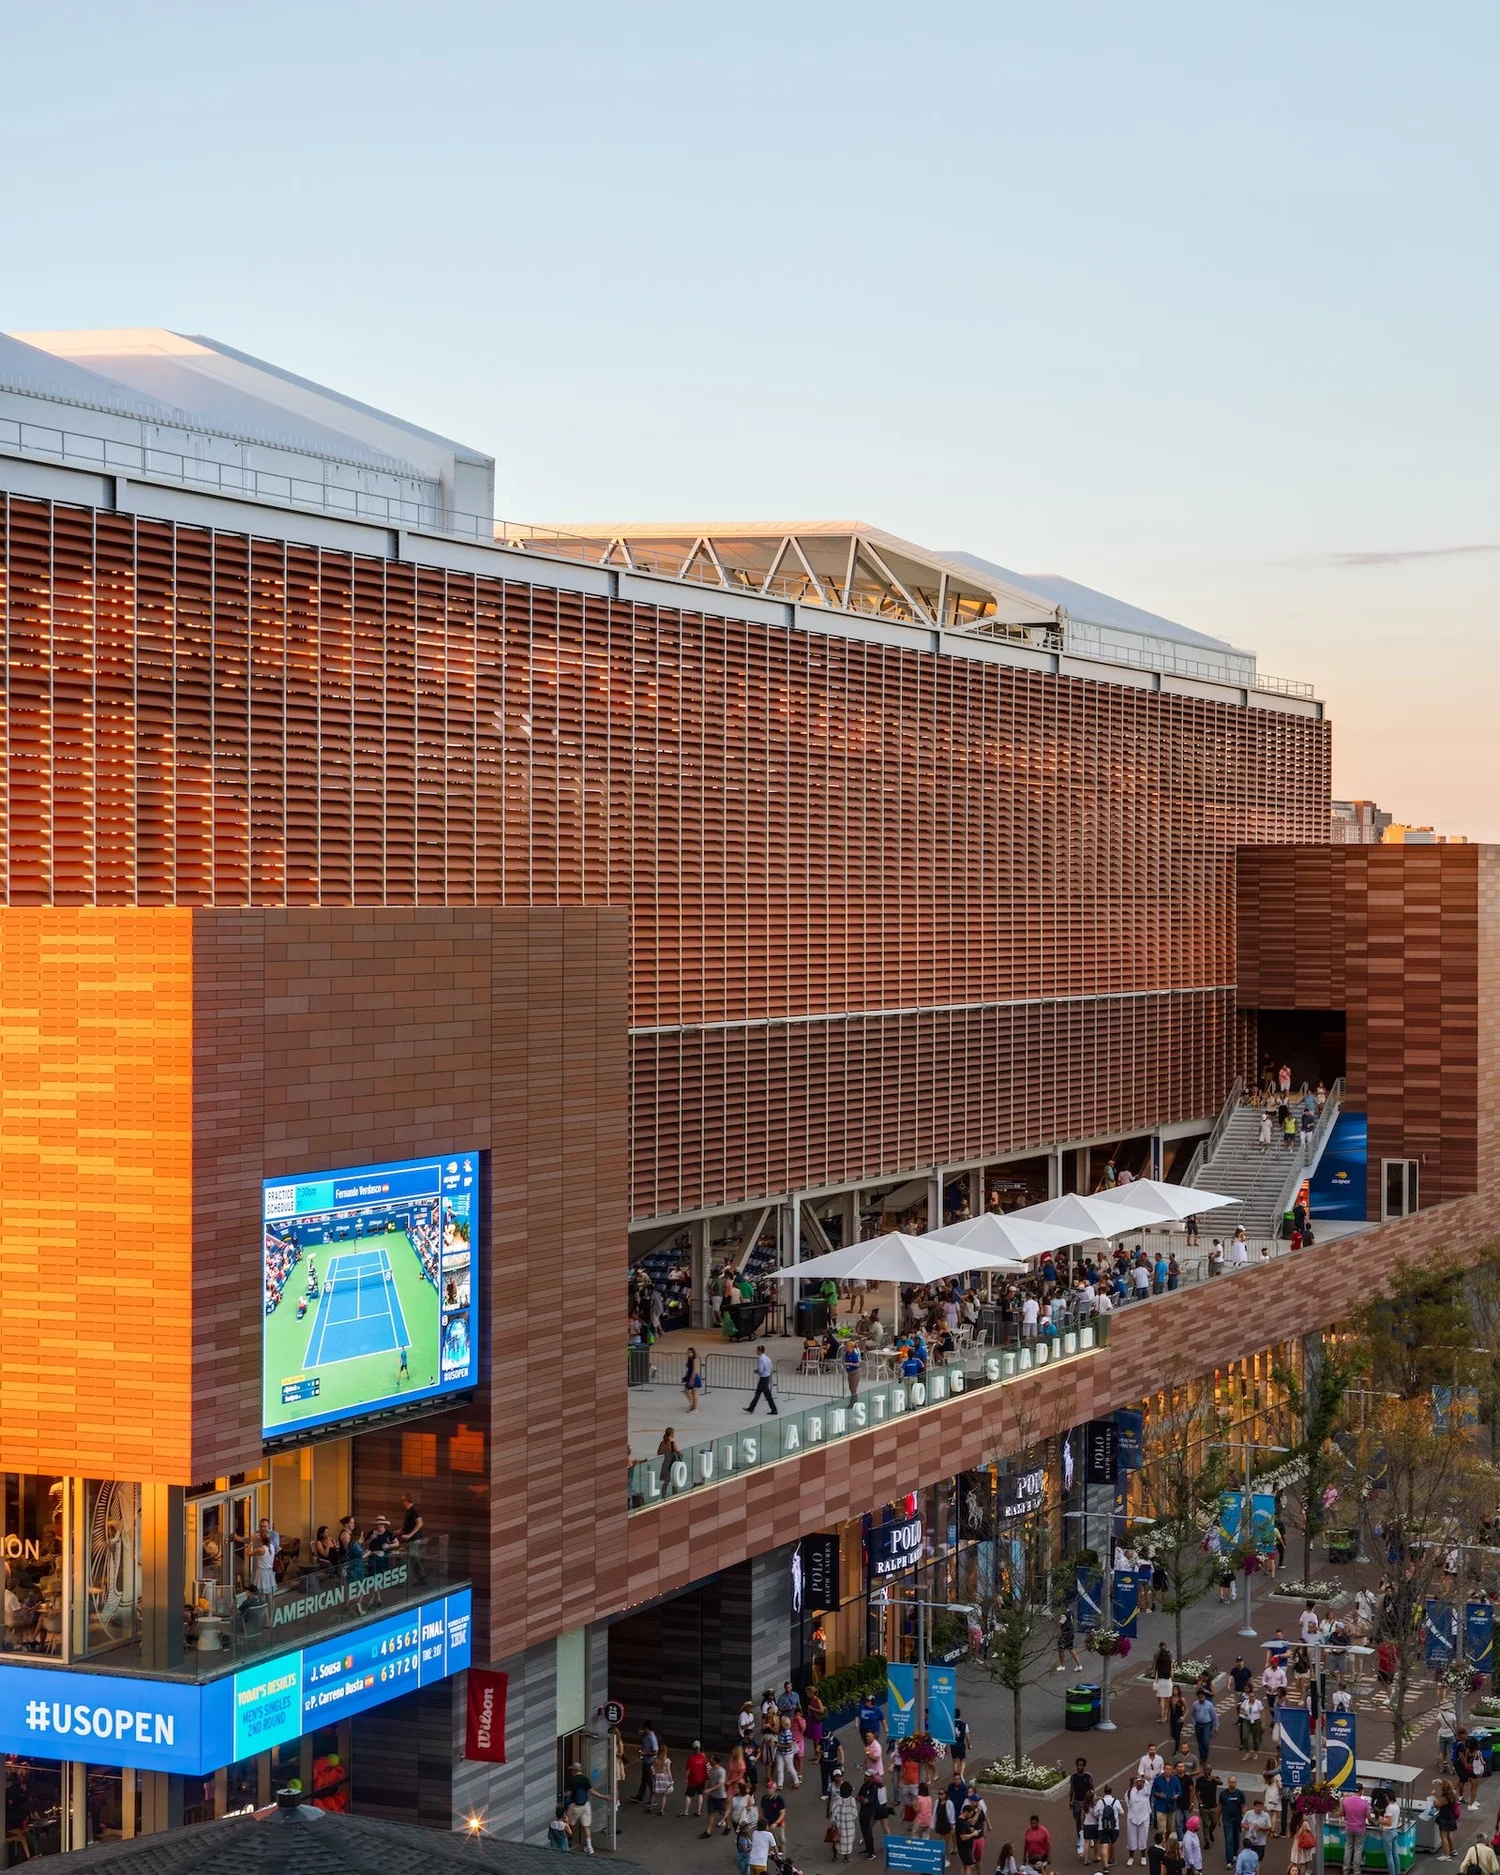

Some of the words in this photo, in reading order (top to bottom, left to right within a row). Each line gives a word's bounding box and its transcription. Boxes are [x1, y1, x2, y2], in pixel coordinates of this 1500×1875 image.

[267, 1201, 294, 1214] SCHEDULE
[268, 1189, 293, 1201] PRACTICE
[335, 1188, 358, 1199] Fernando
[359, 1184, 381, 1196] Verdasco
[444, 1367, 468, 1381] #USOPEN
[647, 1438, 757, 1497] LOUIS
[784, 1369, 964, 1450] ARMSTRONG
[987, 1327, 1093, 1381] STADIUM
[1095, 1436, 1104, 1469] POLO
[890, 1520, 922, 1554] POLO
[812, 1552, 823, 1592] POLO
[876, 1555, 907, 1573] RALPH
[272, 1585, 345, 1628] AMERICAN
[348, 1564, 407, 1600] EXPRESS
[422, 1620, 444, 1641] FINAL
[451, 1629, 466, 1648] IBM
[311, 1666, 318, 1681] J.
[320, 1660, 341, 1678] Sousa
[381, 1640, 387, 1655] 4
[389, 1638, 395, 1653] 6
[397, 1635, 402, 1650] 5
[404, 1632, 410, 1647] 6
[412, 1629, 417, 1644] 2
[237, 1685, 266, 1706] TODAY'S
[267, 1672, 296, 1695] RESULTS
[310, 1695, 318, 1709] P.
[319, 1688, 344, 1705] Carreno
[345, 1679, 363, 1695] Busta
[381, 1666, 387, 1682] 6
[389, 1663, 394, 1679] 3
[397, 1660, 402, 1675] 7
[404, 1657, 410, 1673] 2
[412, 1654, 417, 1669] 0
[26, 1700, 174, 1745] #USOPEN
[243, 1706, 264, 1724] MEN'S
[264, 1695, 291, 1716] SINGLES
[248, 1720, 261, 1737] 2ND
[263, 1712, 286, 1731] ROUND
[478, 1688, 494, 1749] Wilson
